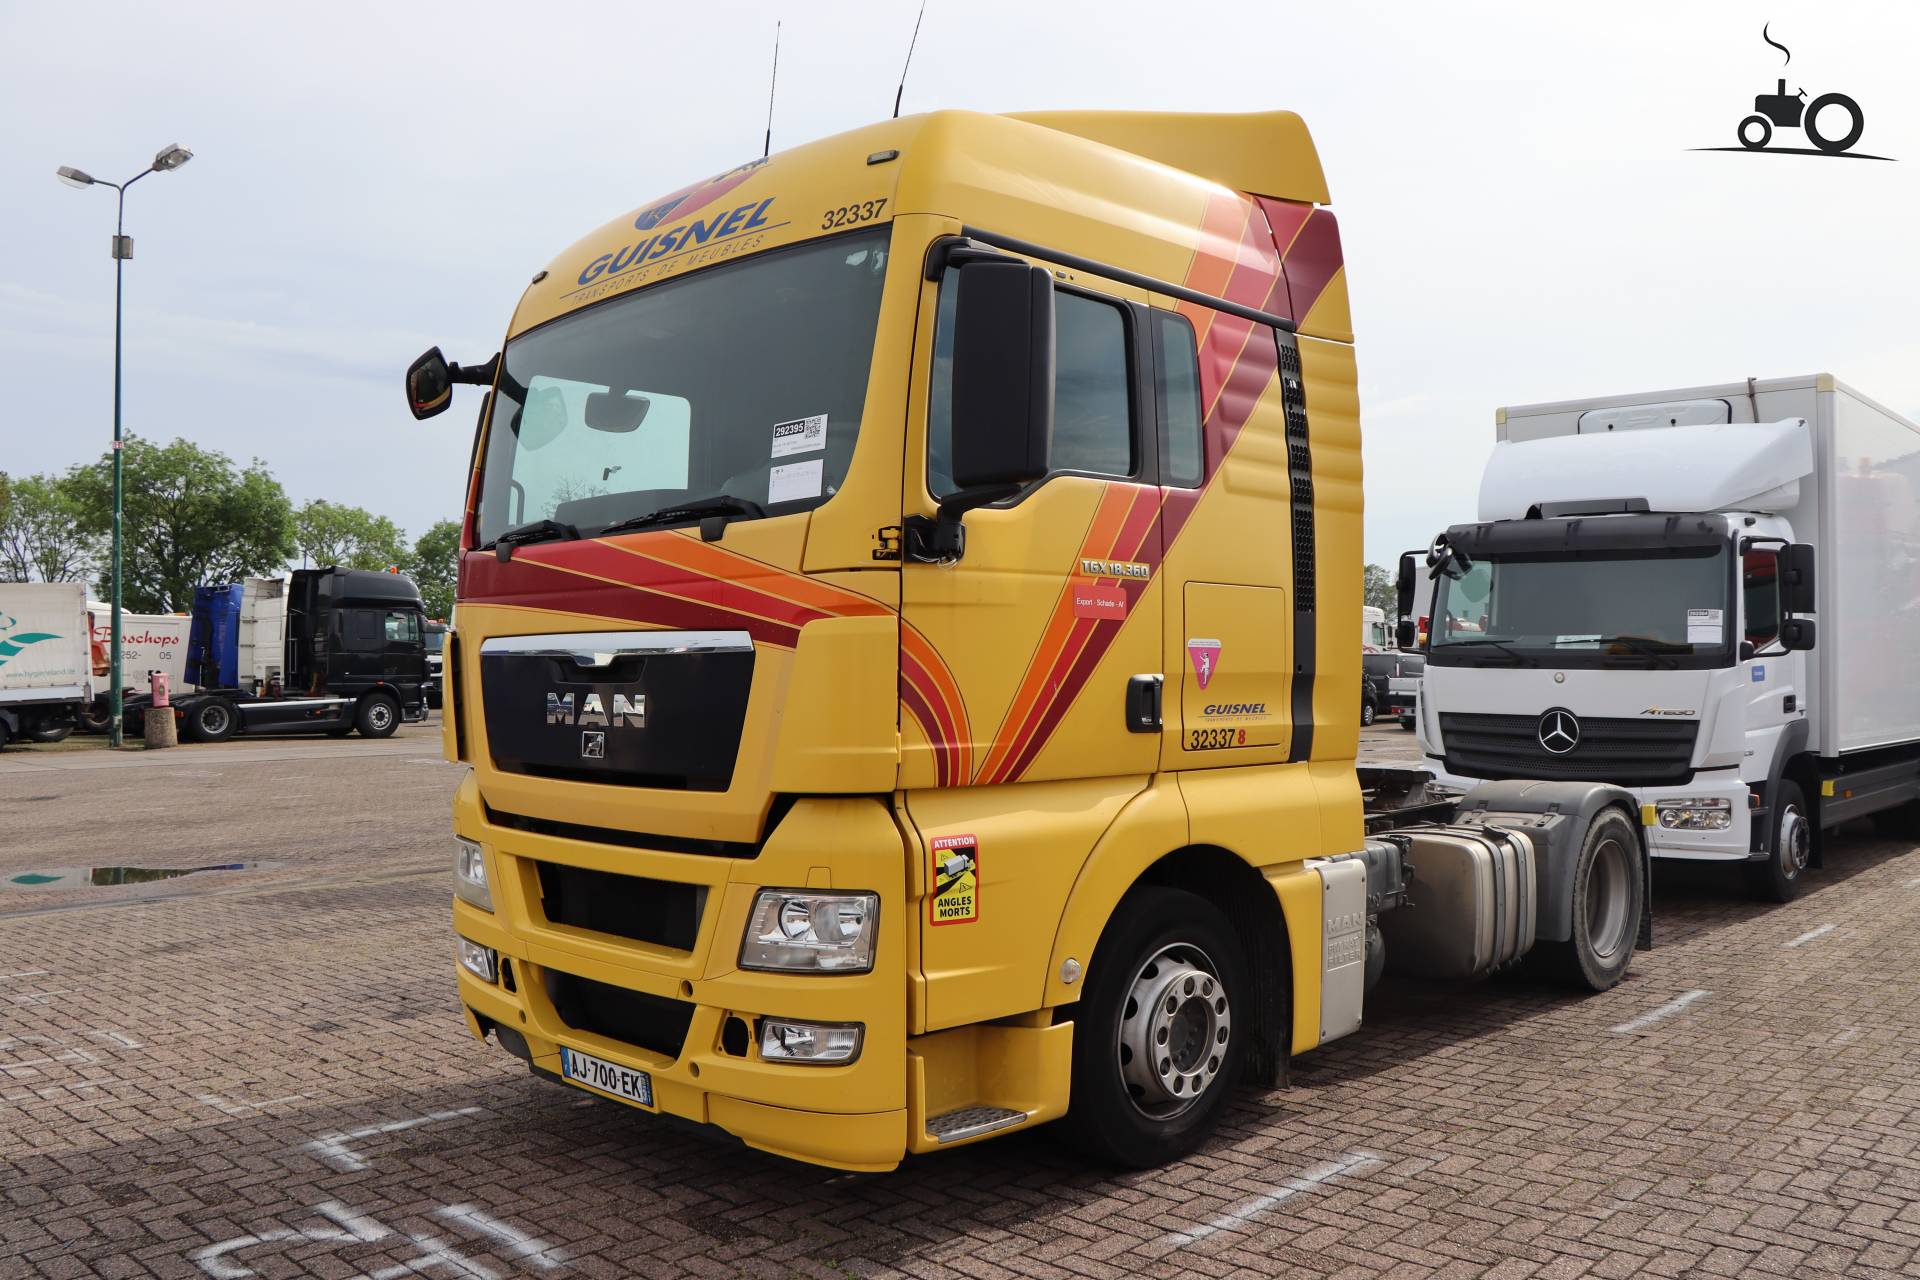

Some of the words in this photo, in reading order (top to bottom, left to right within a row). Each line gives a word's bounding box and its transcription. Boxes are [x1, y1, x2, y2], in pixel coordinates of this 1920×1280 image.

[821, 197, 888, 230] 32337
[577, 196, 777, 286] GUISNEL
[656, 259, 679, 276] DE
[687, 233, 765, 265] MEUBLES
[775, 422, 805, 438] 292395
[1082, 560, 1107, 575] TGX
[1109, 563, 1149, 577] 18.360
[546, 692, 646, 728] MAN
[1203, 703, 1266, 715] GUISNEL
[1190, 728, 1236, 750] 32337
[1237, 729, 1246, 745] 8
[934, 836, 975, 849] ATTENTION
[937, 895, 972, 908] ANGLES
[939, 906, 971, 918] MORTS
[1327, 911, 1364, 936] MAN
